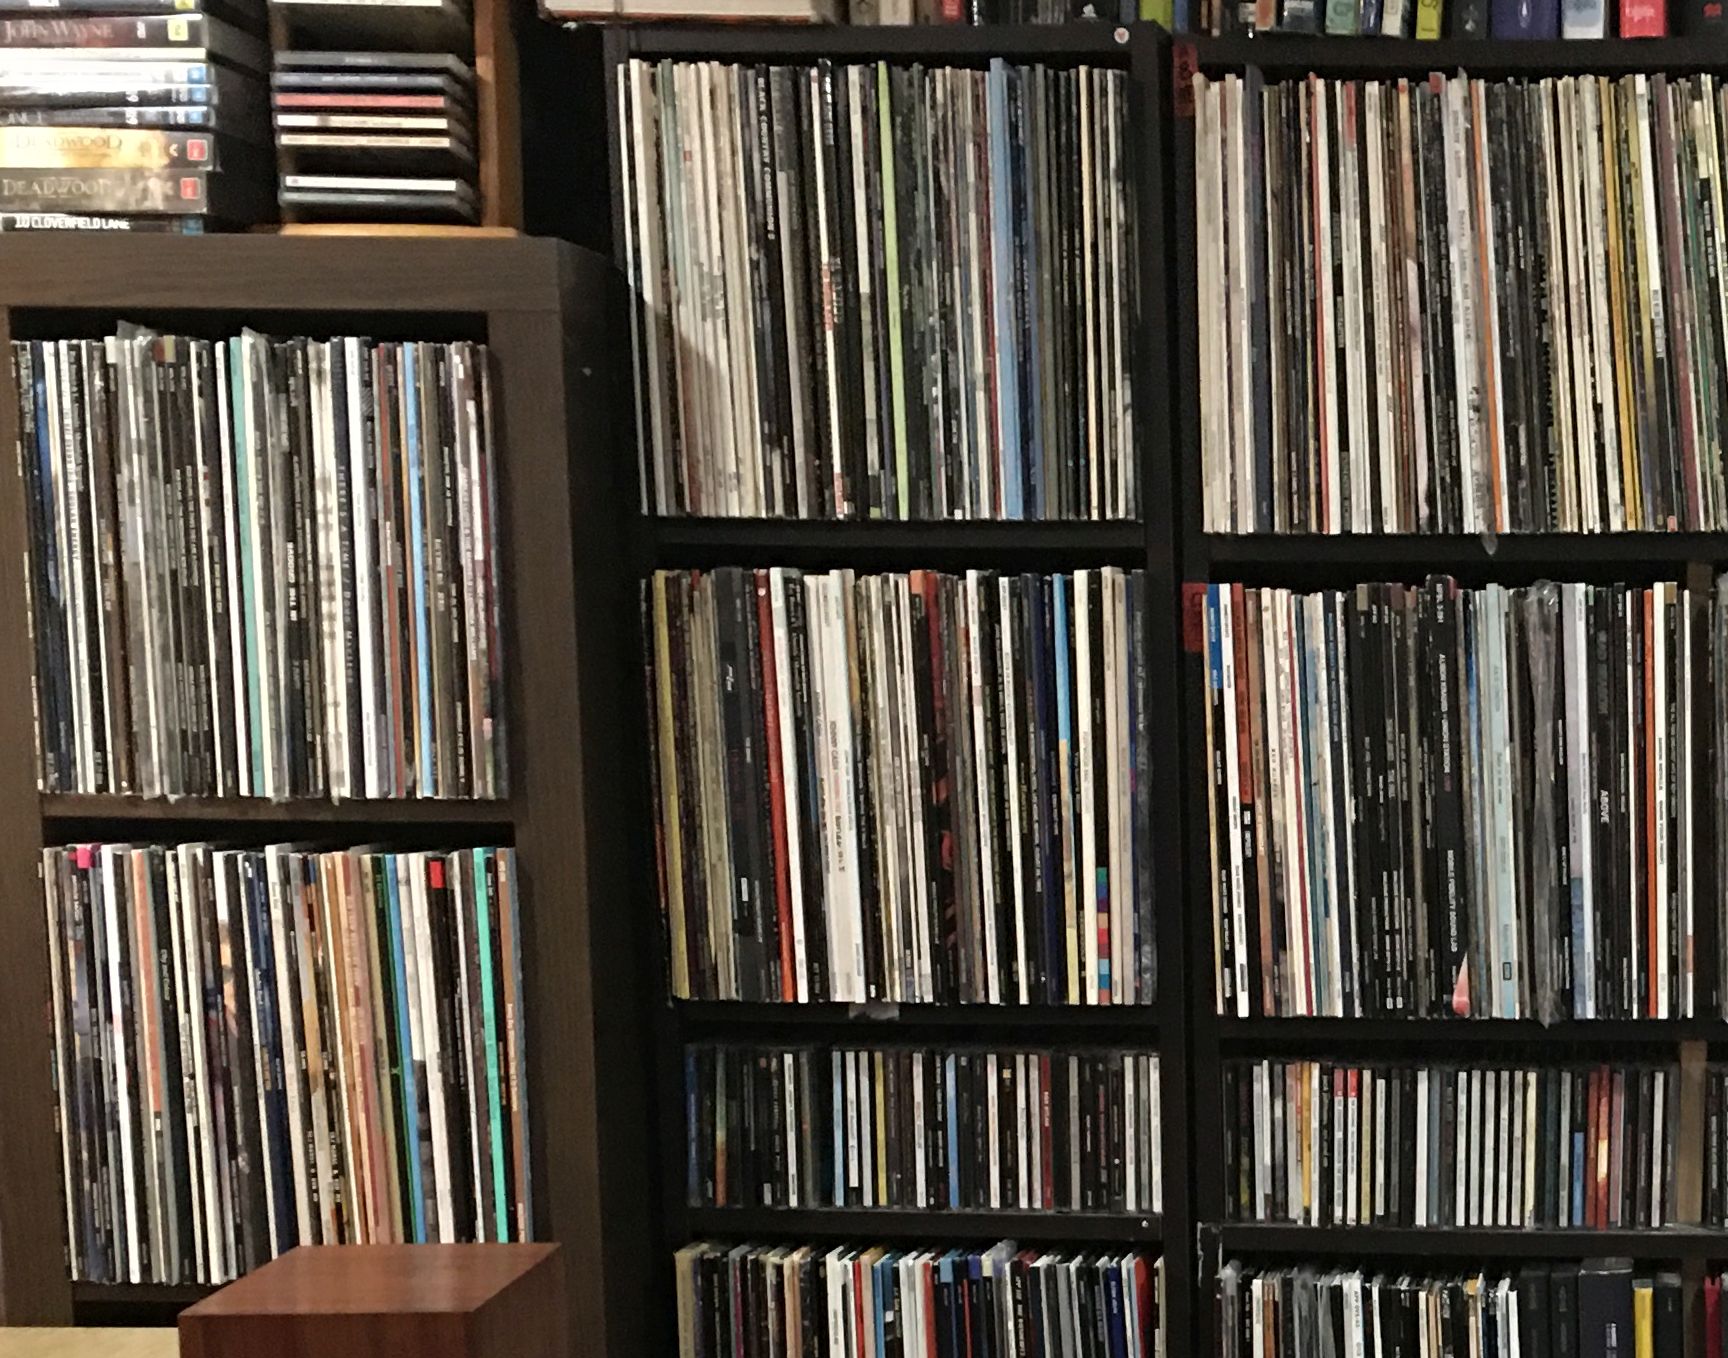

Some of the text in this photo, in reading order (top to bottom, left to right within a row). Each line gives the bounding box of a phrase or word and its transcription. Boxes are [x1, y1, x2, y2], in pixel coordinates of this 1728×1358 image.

[5, 21, 47, 43] JOHN
[757, 78, 767, 111] BLACK
[760, 116, 770, 163] COUNTRY
[31, 216, 100, 229] CLOVERFIELD
[1600, 790, 1609, 824] ABOVE
